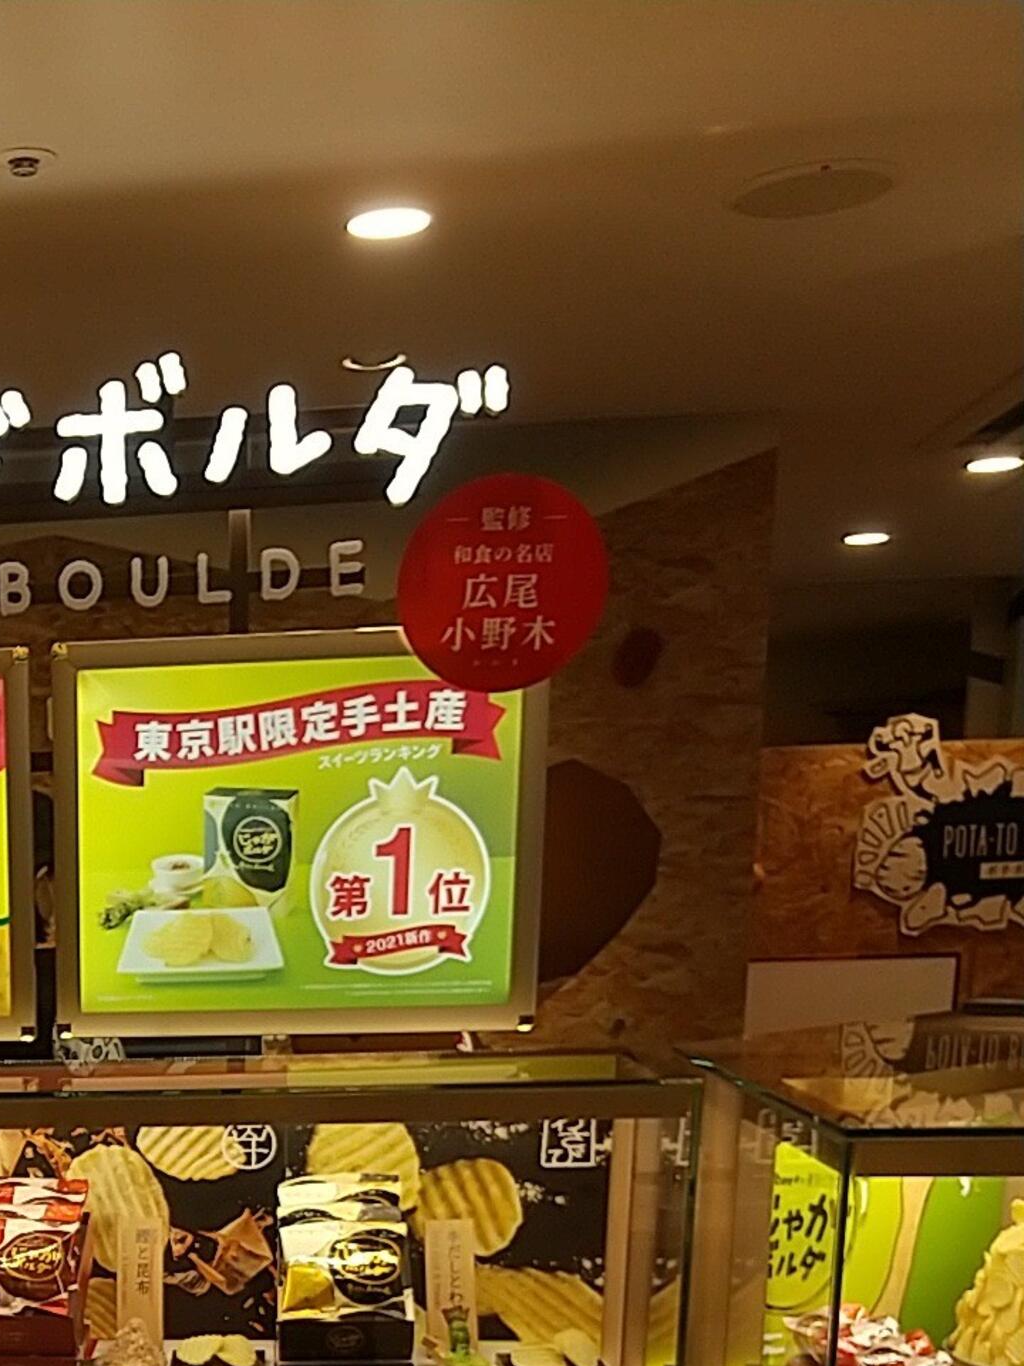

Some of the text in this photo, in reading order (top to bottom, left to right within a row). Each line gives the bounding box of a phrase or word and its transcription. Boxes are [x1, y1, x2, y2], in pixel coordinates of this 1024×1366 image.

[480, 506, 533, 531] 監修
[453, 543, 554, 565] 和食の名店
[462, 573, 539, 610] 広尾
[440, 615, 556, 652] 小野木
[133, 688, 467, 762] 東京駅限定手土産
[317, 743, 443, 771] スイーツランキング
[328, 826, 472, 918] 第1位
[366, 929, 433, 955] 2021新作
